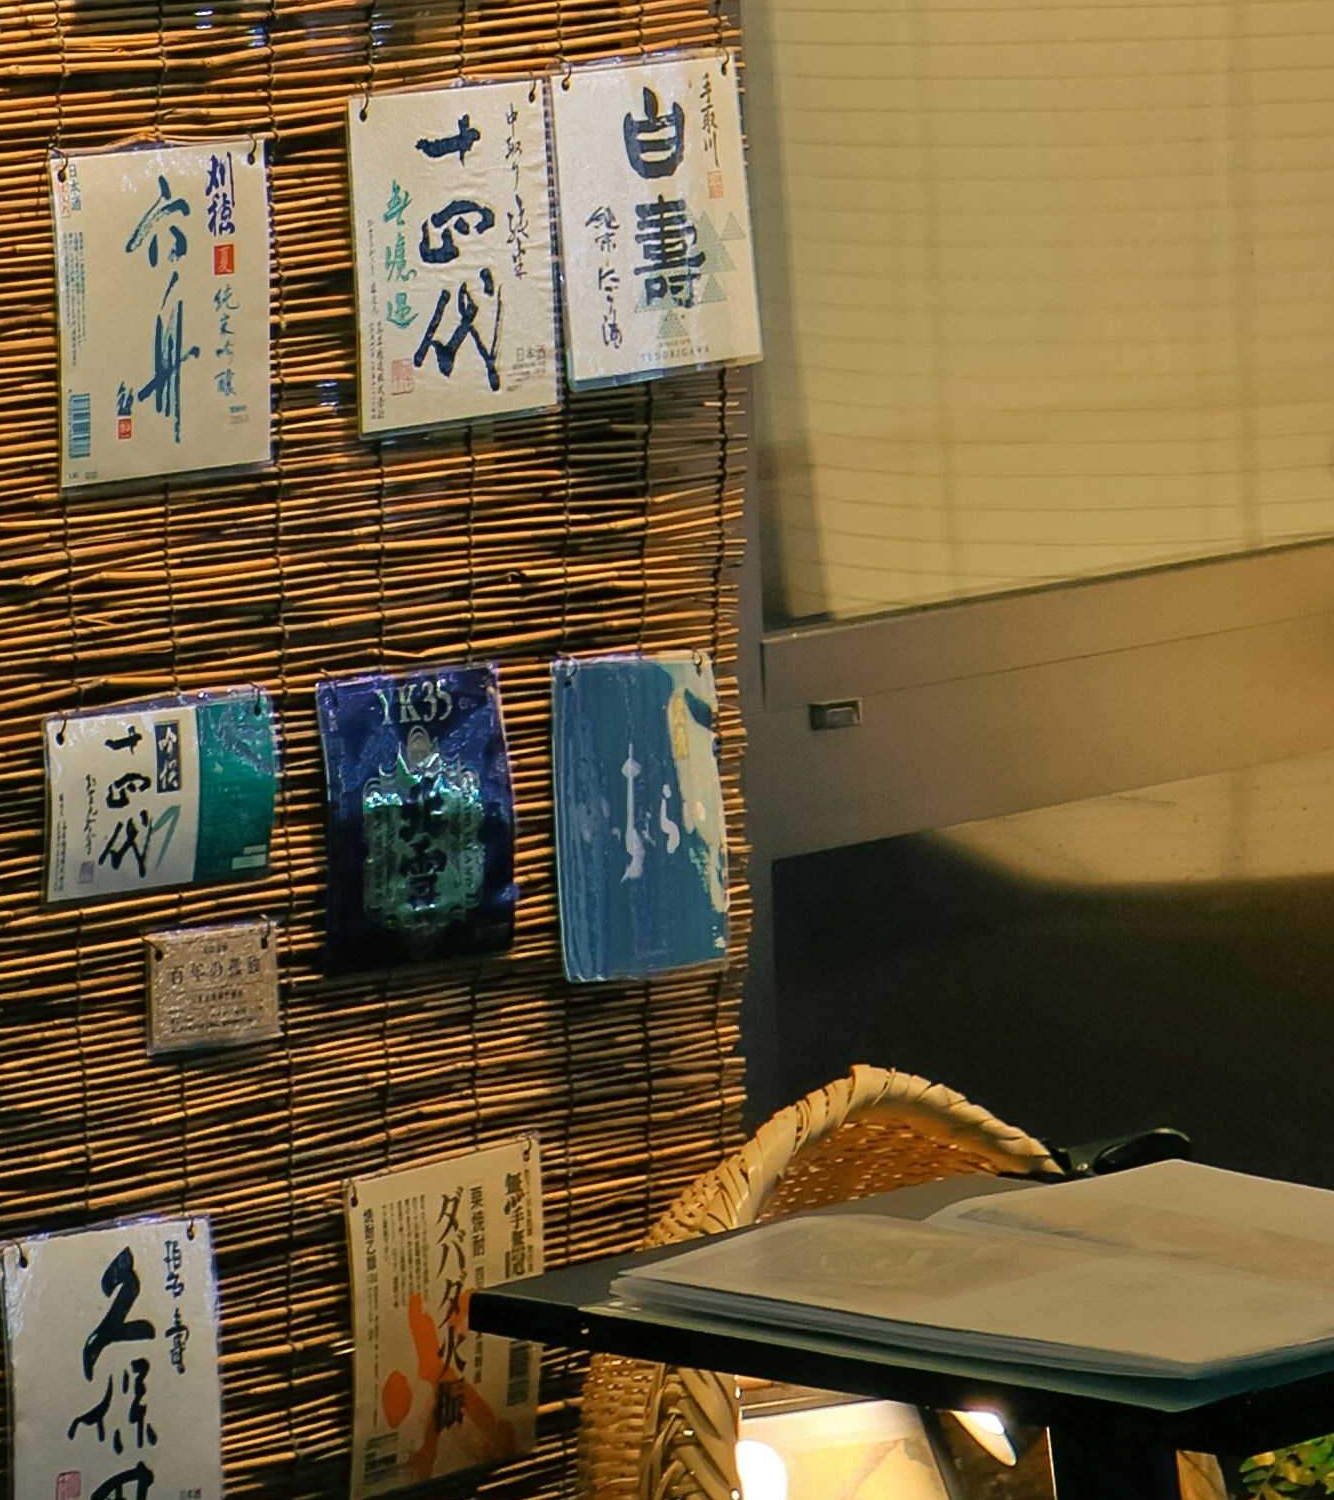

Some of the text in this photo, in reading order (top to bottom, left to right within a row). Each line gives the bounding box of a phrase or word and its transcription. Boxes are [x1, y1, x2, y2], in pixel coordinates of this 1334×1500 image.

[699, 73, 720, 168] 手取川
[217, 246, 235, 275] 夏
[413, 113, 502, 392] 十四代
[377, 680, 453, 726] YK35
[98, 725, 152, 878] 十四代
